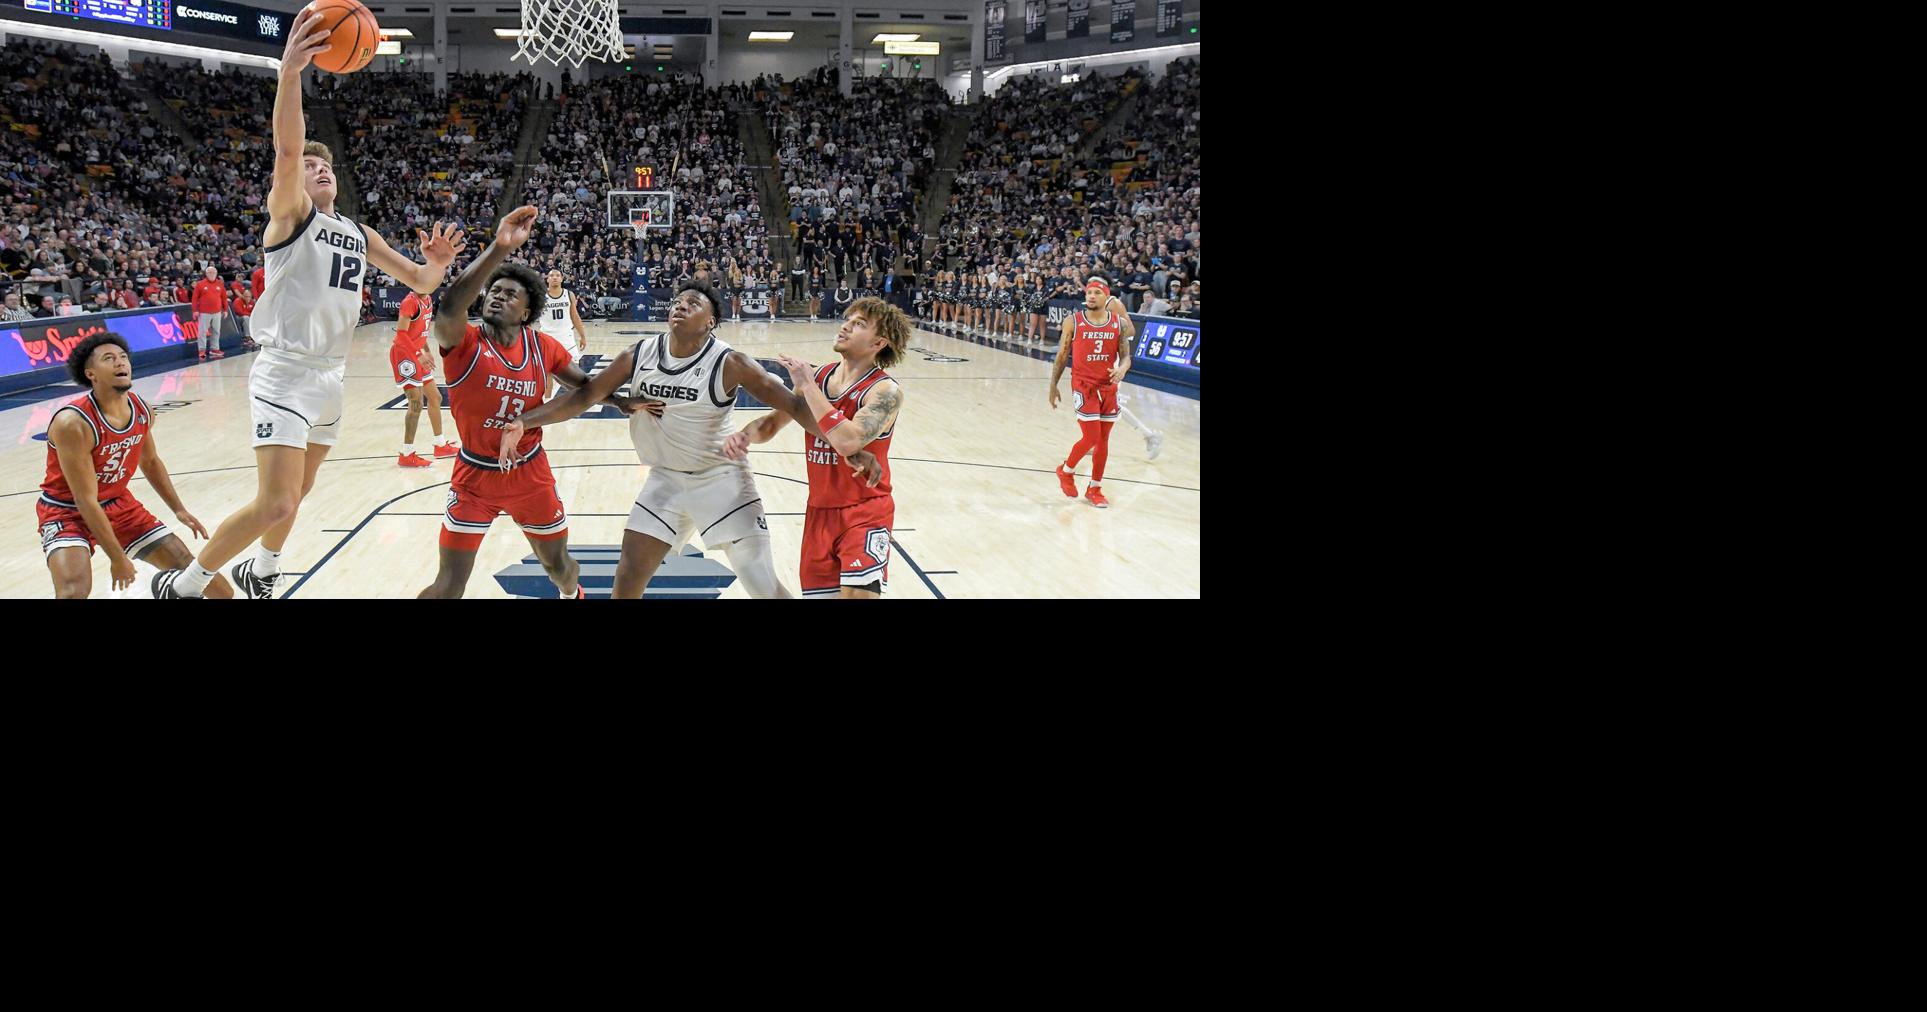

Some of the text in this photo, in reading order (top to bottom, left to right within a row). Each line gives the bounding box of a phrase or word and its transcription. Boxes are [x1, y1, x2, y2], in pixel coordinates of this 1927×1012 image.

[186, 9, 238, 24] CONSERVICE
[260, 15, 278, 24] NEW
[258, 20, 280, 31] YORK
[260, 27, 279, 37] LIFE
[635, 166, 652, 176] 9:57
[637, 176, 650, 188] 11
[329, 252, 361, 292] 12
[741, 298, 770, 306] STATE
[552, 309, 564, 320] 10
[1082, 331, 1115, 340] FRESNO
[1172, 331, 1193, 348] 9:57
[1093, 340, 1104, 354] 3
[1149, 341, 1162, 356] 56
[486, 375, 537, 397] FRESNO
[640, 381, 699, 401] AGGIES
[496, 395, 525, 420] 13
[807, 449, 838, 465] STATE
